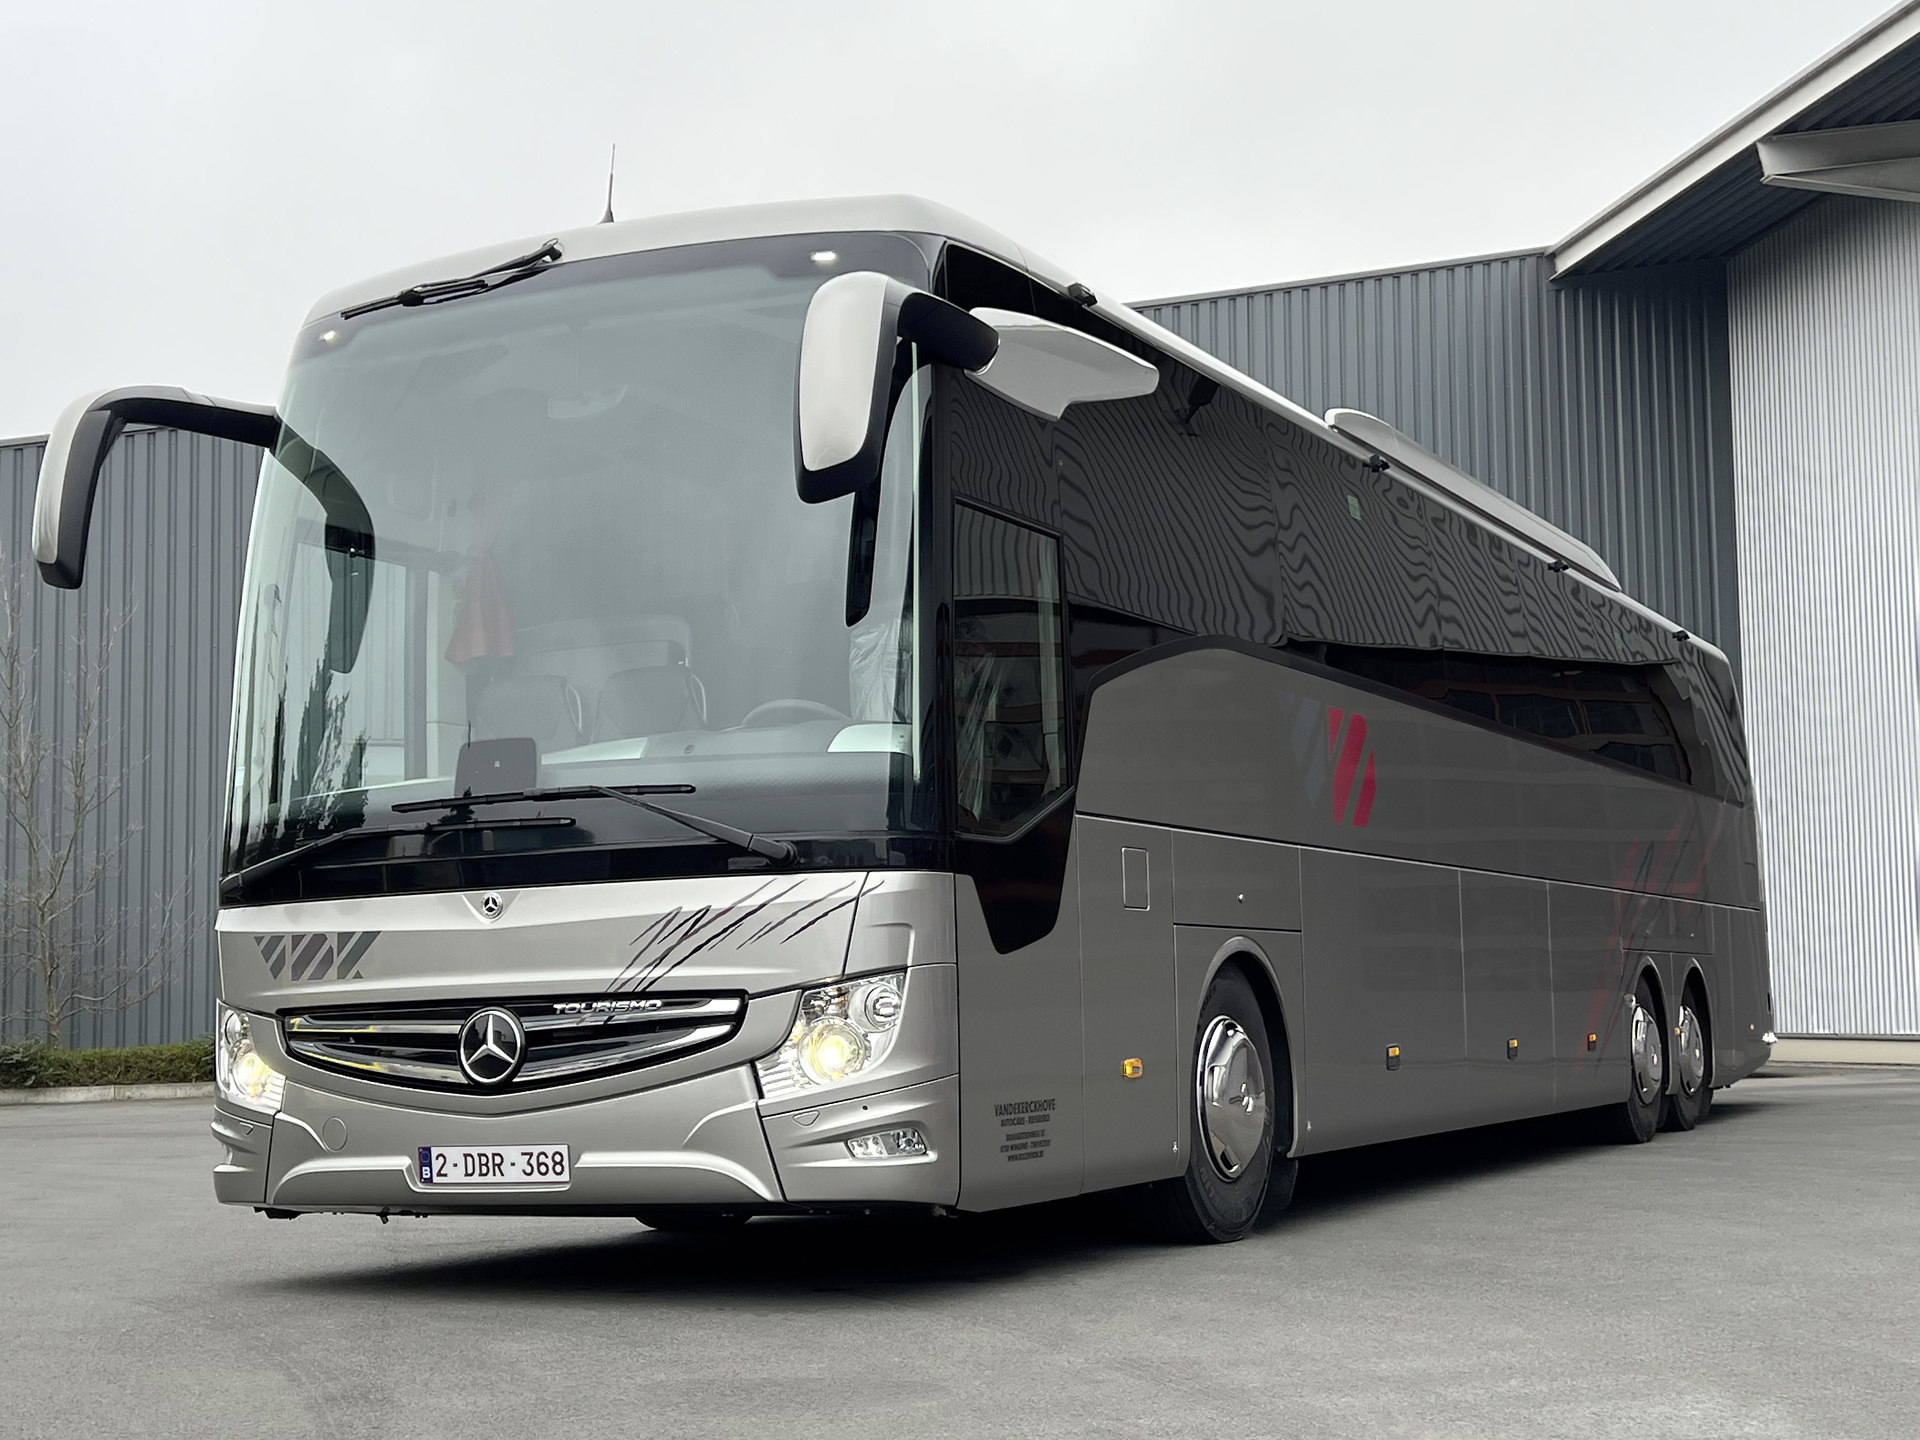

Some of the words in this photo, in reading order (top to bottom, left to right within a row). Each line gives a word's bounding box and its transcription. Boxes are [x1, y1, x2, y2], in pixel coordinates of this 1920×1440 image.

[553, 1000, 662, 1014] TOURISMO
[994, 1098, 1056, 1117] VANDEKERCKHOVE
[422, 1166, 431, 1178] B
